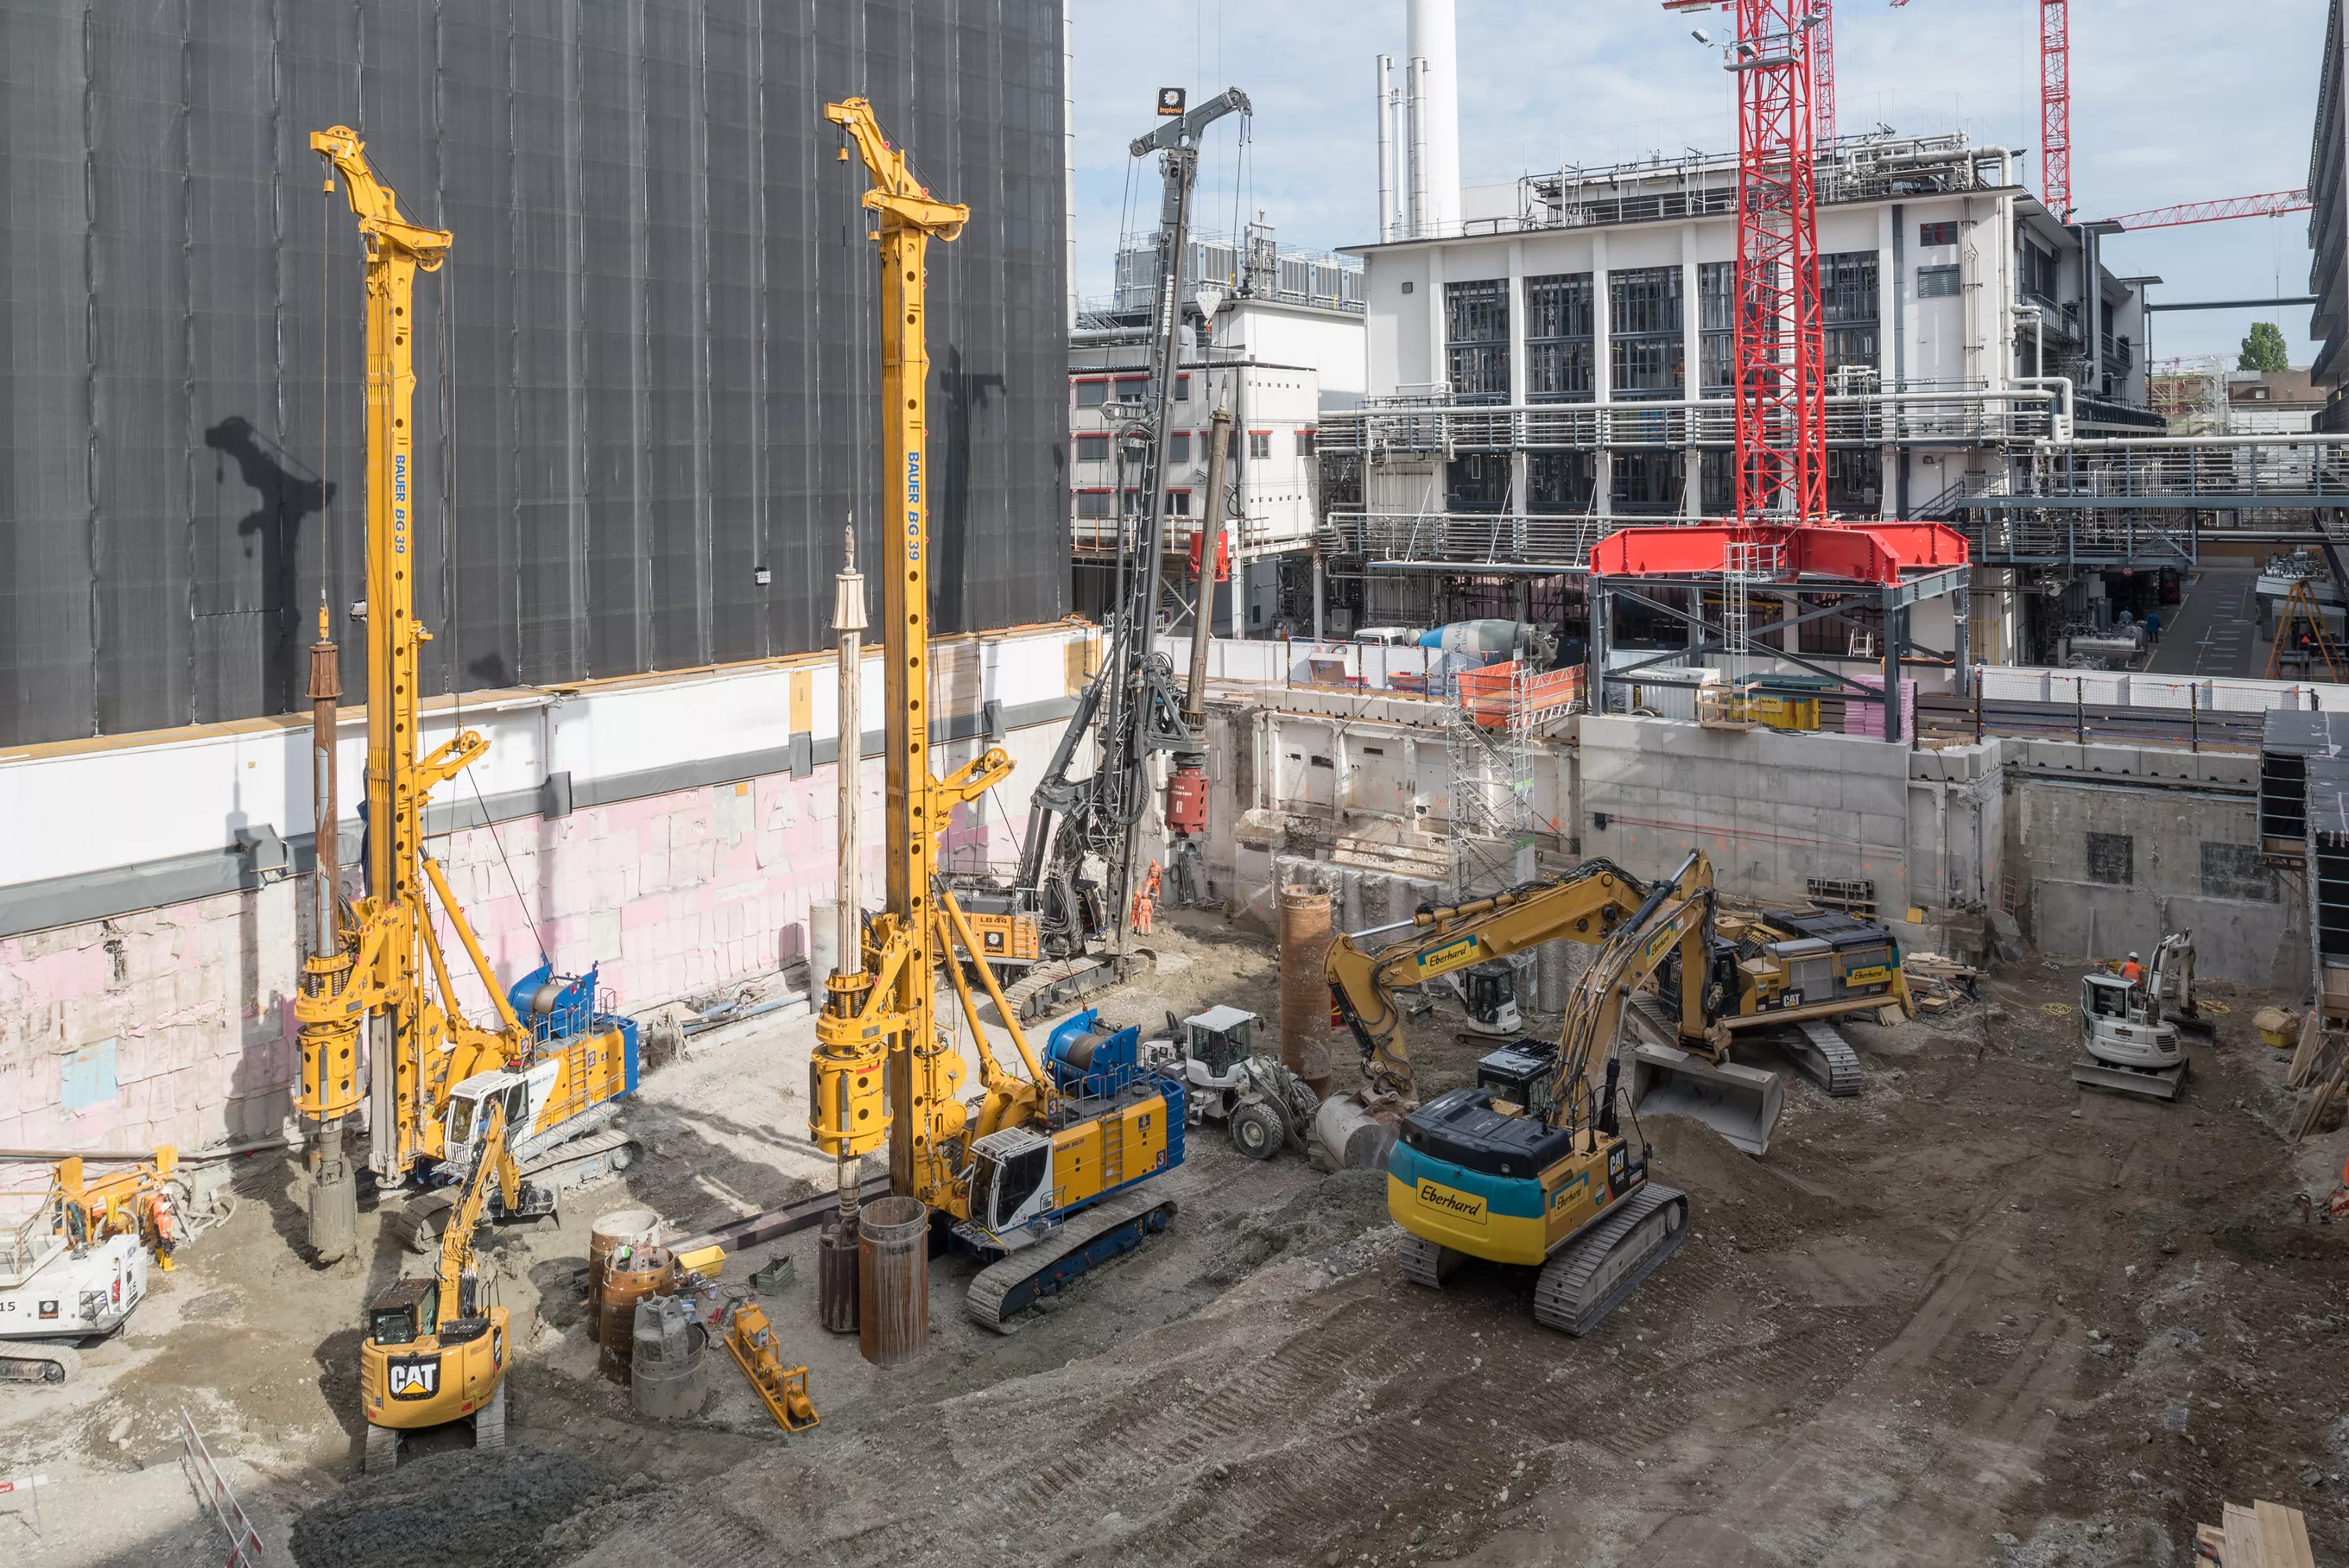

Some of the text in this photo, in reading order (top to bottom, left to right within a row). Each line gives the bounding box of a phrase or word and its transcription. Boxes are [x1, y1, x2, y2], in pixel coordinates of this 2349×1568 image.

[395, 455, 406, 553] BAUER BG 39
[908, 452, 920, 560] BAUER BG 39
[1429, 945, 1466, 967] Eberhard
[1853, 969, 1884, 980] Eberhard
[1783, 994, 1801, 1008] CAT
[522, 1040, 529, 1054] 2
[588, 1053, 595, 1065] 2
[1049, 1100, 1057, 1114] 3
[1157, 1153, 1164, 1166] 3
[1610, 1148, 1624, 1176] CAT
[1421, 1185, 1482, 1216] Eberhard
[1556, 1184, 1583, 1211] Eberhard
[129, 1280, 136, 1296] 15
[390, 1363, 437, 1394] CAT
